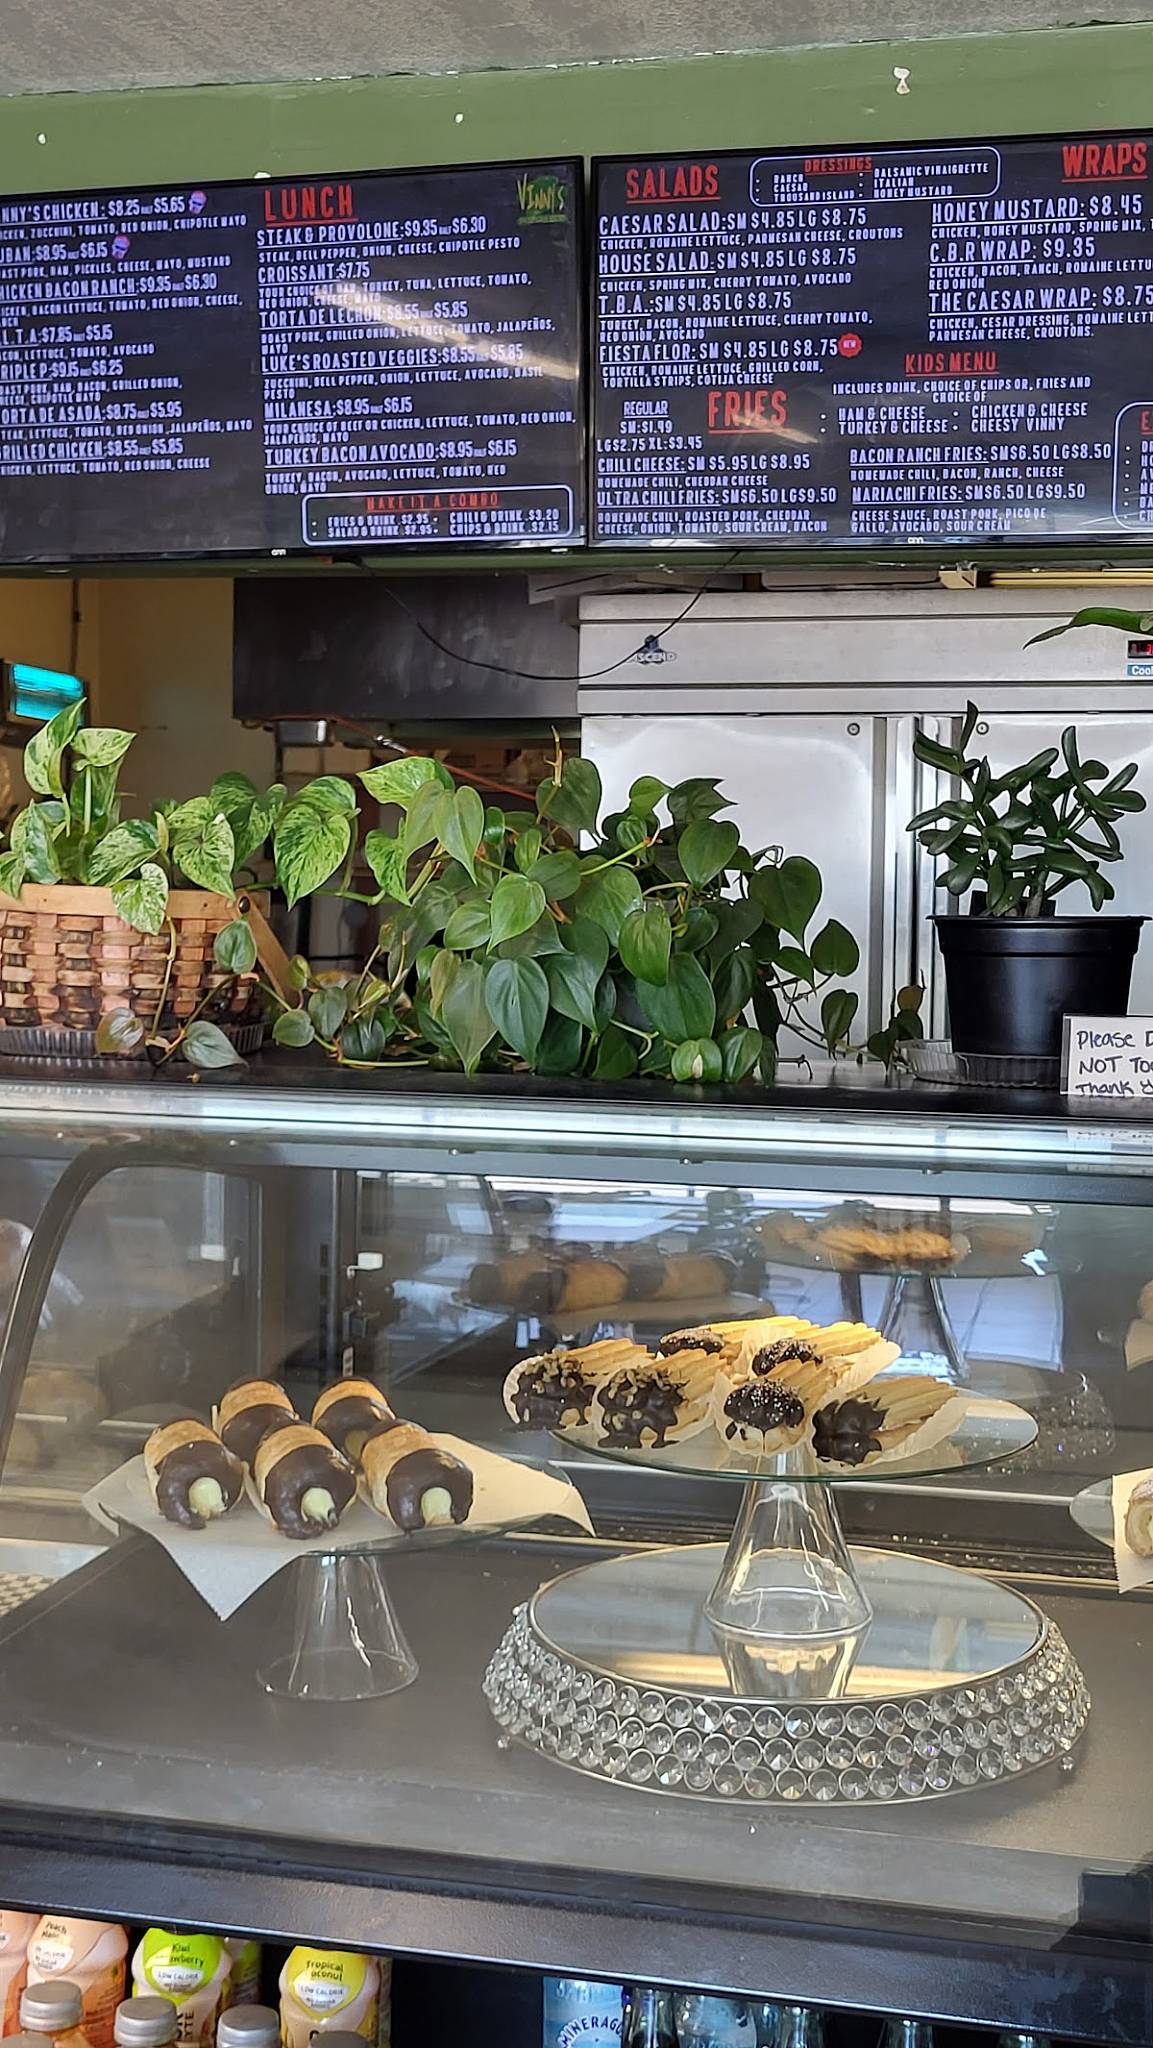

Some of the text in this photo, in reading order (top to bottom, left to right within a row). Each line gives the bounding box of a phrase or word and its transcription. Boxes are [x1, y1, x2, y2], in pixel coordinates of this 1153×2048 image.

[804, 157, 873, 173] DRESSINGS
[1062, 142, 1147, 177] WRAPS
[625, 164, 719, 199] SALADS
[874, 177, 914, 188] ITALIAN
[264, 184, 353, 221] LUNCH
[932, 201, 989, 224] HONEY
[1089, 194, 1142, 216] $8.45
[599, 213, 663, 235] CAESAR
[751, 210, 795, 229] $4.85
[798, 209, 817, 227] LG
[822, 207, 867, 226] $8.75
[983, 225, 1018, 237] HONEY
[1079, 219, 1119, 233] SPRING
[257, 227, 302, 246] STEAK
[488, 237, 520, 249] PESTO
[650, 236, 693, 248] ROMAINE
[747, 231, 801, 244] PARMESAN
[848, 227, 904, 241] CROUTONS
[1043, 237, 1095, 258] $9.35
[599, 254, 651, 274] HOUSE
[740, 250, 785, 269] $4.85
[788, 249, 807, 267] LG
[811, 247, 856, 266] $8.75
[649, 278, 686, 290] SPRING
[713, 276, 752, 289] CHERRY
[804, 272, 852, 285] AVOCADO
[678, 294, 721, 312] $4.85
[725, 293, 743, 311] LG
[748, 291, 791, 309] $8.75
[928, 292, 962, 312] THE
[966, 289, 1034, 311] CAESAR
[1102, 284, 1153, 307] $8.75
[259, 310, 306, 328] TORTA
[309, 308, 325, 326] DE
[929, 328, 985, 342] PARMESAN
[600, 345, 651, 362] FIESTA
[700, 342, 719, 360] SM
[723, 340, 767, 358] $4.85
[771, 339, 789, 357] LG
[793, 338, 838, 356] $8.75
[262, 353, 310, 372] LUKE'S
[313, 351, 376, 370] ROASTED
[905, 351, 996, 373] KIDS MENU
[737, 372, 774, 385] CHEESE
[833, 382, 884, 395] INCLUDES
[924, 380, 961, 392] CHOICE
[963, 379, 977, 391] OF
[980, 379, 1012, 391] CHIPS
[624, 400, 669, 416] REGULAR
[707, 389, 787, 428] FRIES
[838, 406, 926, 421] HAM CHEESE
[971, 402, 1088, 419] CHICKEN CHEESE
[838, 419, 949, 435] TURKEY CHEESE
[971, 417, 1065, 432] CHEESY VINNY
[264, 447, 318, 465] TURKEY
[321, 446, 368, 463] BACON
[598, 457, 631, 472] CHILI
[709, 455, 748, 470] $5.95
[751, 454, 767, 469] LG
[770, 453, 810, 469] $8.95
[850, 447, 894, 464] BACON
[897, 447, 941, 462] RANCH
[449, 492, 498, 507] COMBO
[597, 491, 639, 505] ULTRA
[642, 490, 676, 504] CHILI
[852, 486, 916, 502] MARIACHI
[1077, 1030, 1136, 1050] Please
[1079, 1055, 1123, 1075] NOT
[1075, 1080, 1135, 1097] Thank
